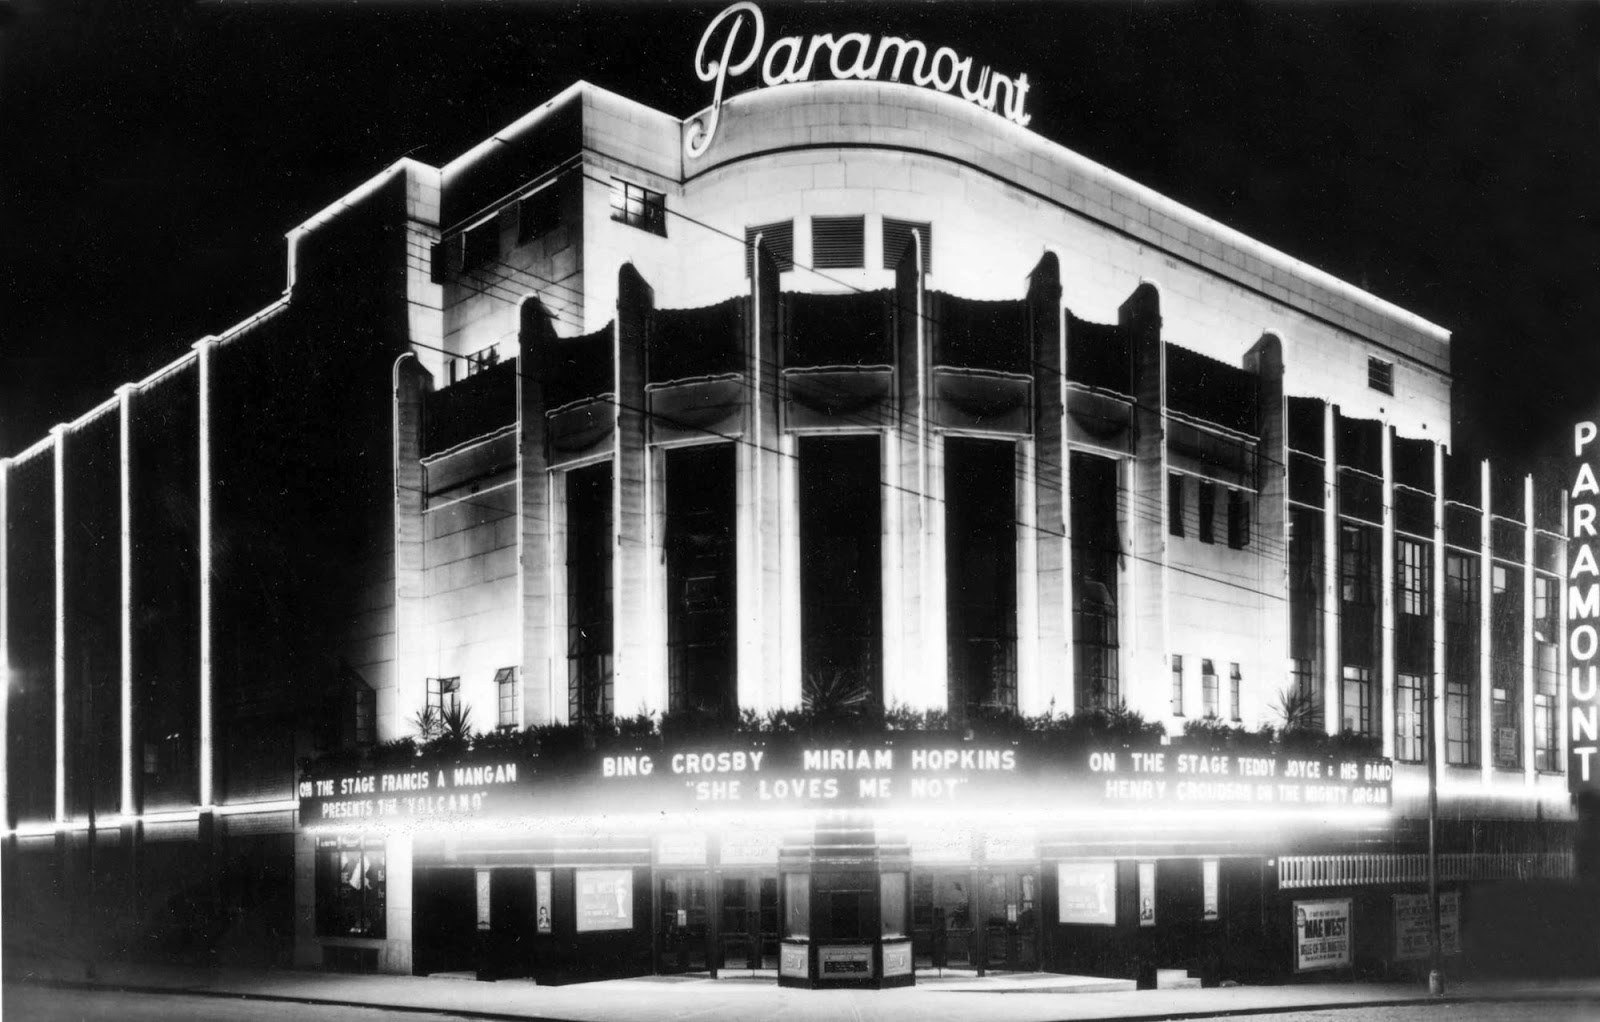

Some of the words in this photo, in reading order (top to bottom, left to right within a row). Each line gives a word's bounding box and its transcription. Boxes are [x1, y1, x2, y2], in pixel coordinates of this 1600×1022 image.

[686, 1, 1032, 157] Paramount
[1568, 421, 1600, 782] PARAMOUNT
[602, 756, 654, 777] BING
[671, 751, 764, 774] CROSBY
[803, 749, 893, 771] MIRIAM
[911, 749, 1016, 770] HOPKINS
[1089, 752, 1117, 773] ON
[1131, 752, 1165, 773] THE
[1177, 754, 1229, 775] STAGE
[1237, 757, 1276, 777] TEDDY
[1284, 760, 1320, 779] JOYCE
[1340, 763, 1358, 780] HIS
[1364, 763, 1392, 782] BAND
[299, 781, 313, 798] ON
[316, 780, 335, 797] THE
[340, 776, 375, 795] STAGE
[382, 772, 429, 793] FRANCIS
[436, 769, 446, 788] A
[453, 763, 517, 787] MANGAN
[759, 779, 839, 799] LOVES
[859, 778, 891, 798] ME
[1104, 779, 1167, 799] HENRY
[1277, 783, 1300, 802] THE
[1351, 786, 1388, 804] ORGAN
[321, 800, 374, 819] PRESENTS
[1305, 919, 1323, 939] MAE
[1324, 917, 1347, 937] WEST
